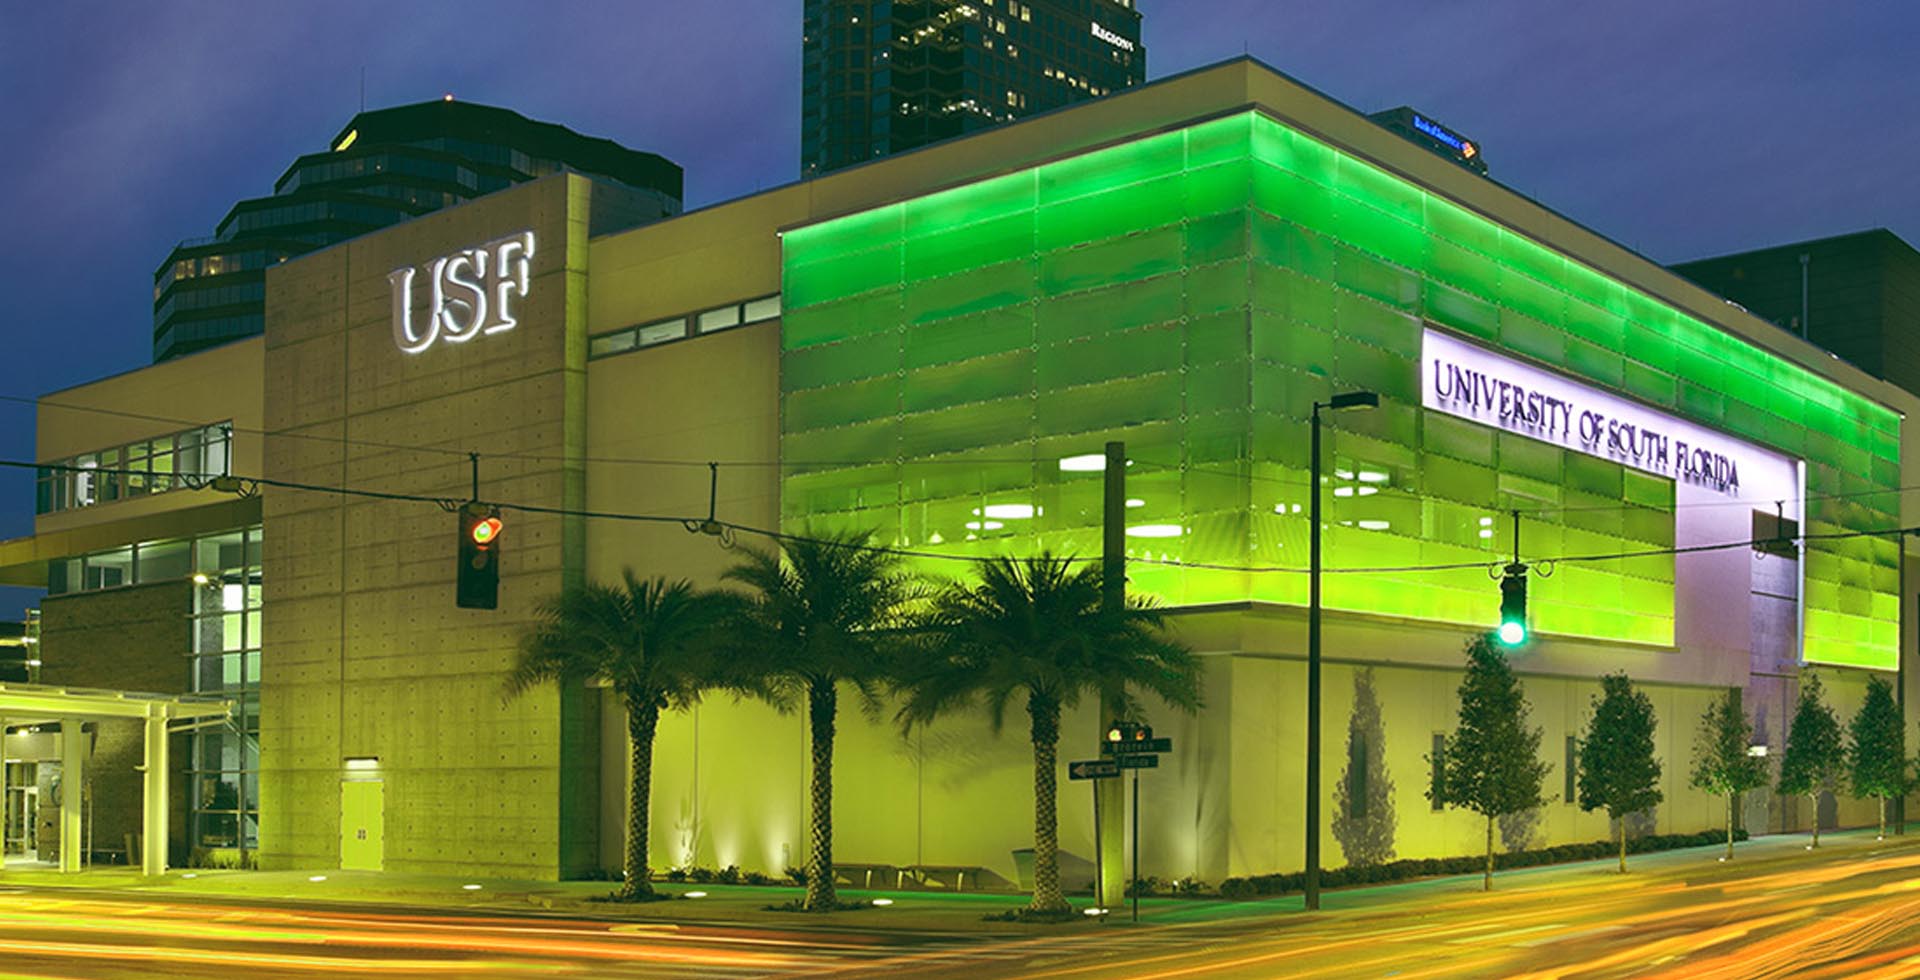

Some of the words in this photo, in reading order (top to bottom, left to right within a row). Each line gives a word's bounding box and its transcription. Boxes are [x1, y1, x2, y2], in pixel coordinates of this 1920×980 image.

[387, 231, 535, 354] USF
[1434, 359, 1573, 433] UNIVERSITY
[1579, 410, 1604, 444] OF
[1607, 419, 1669, 465] SOUTH
[1675, 441, 1740, 488] FLORIDA
